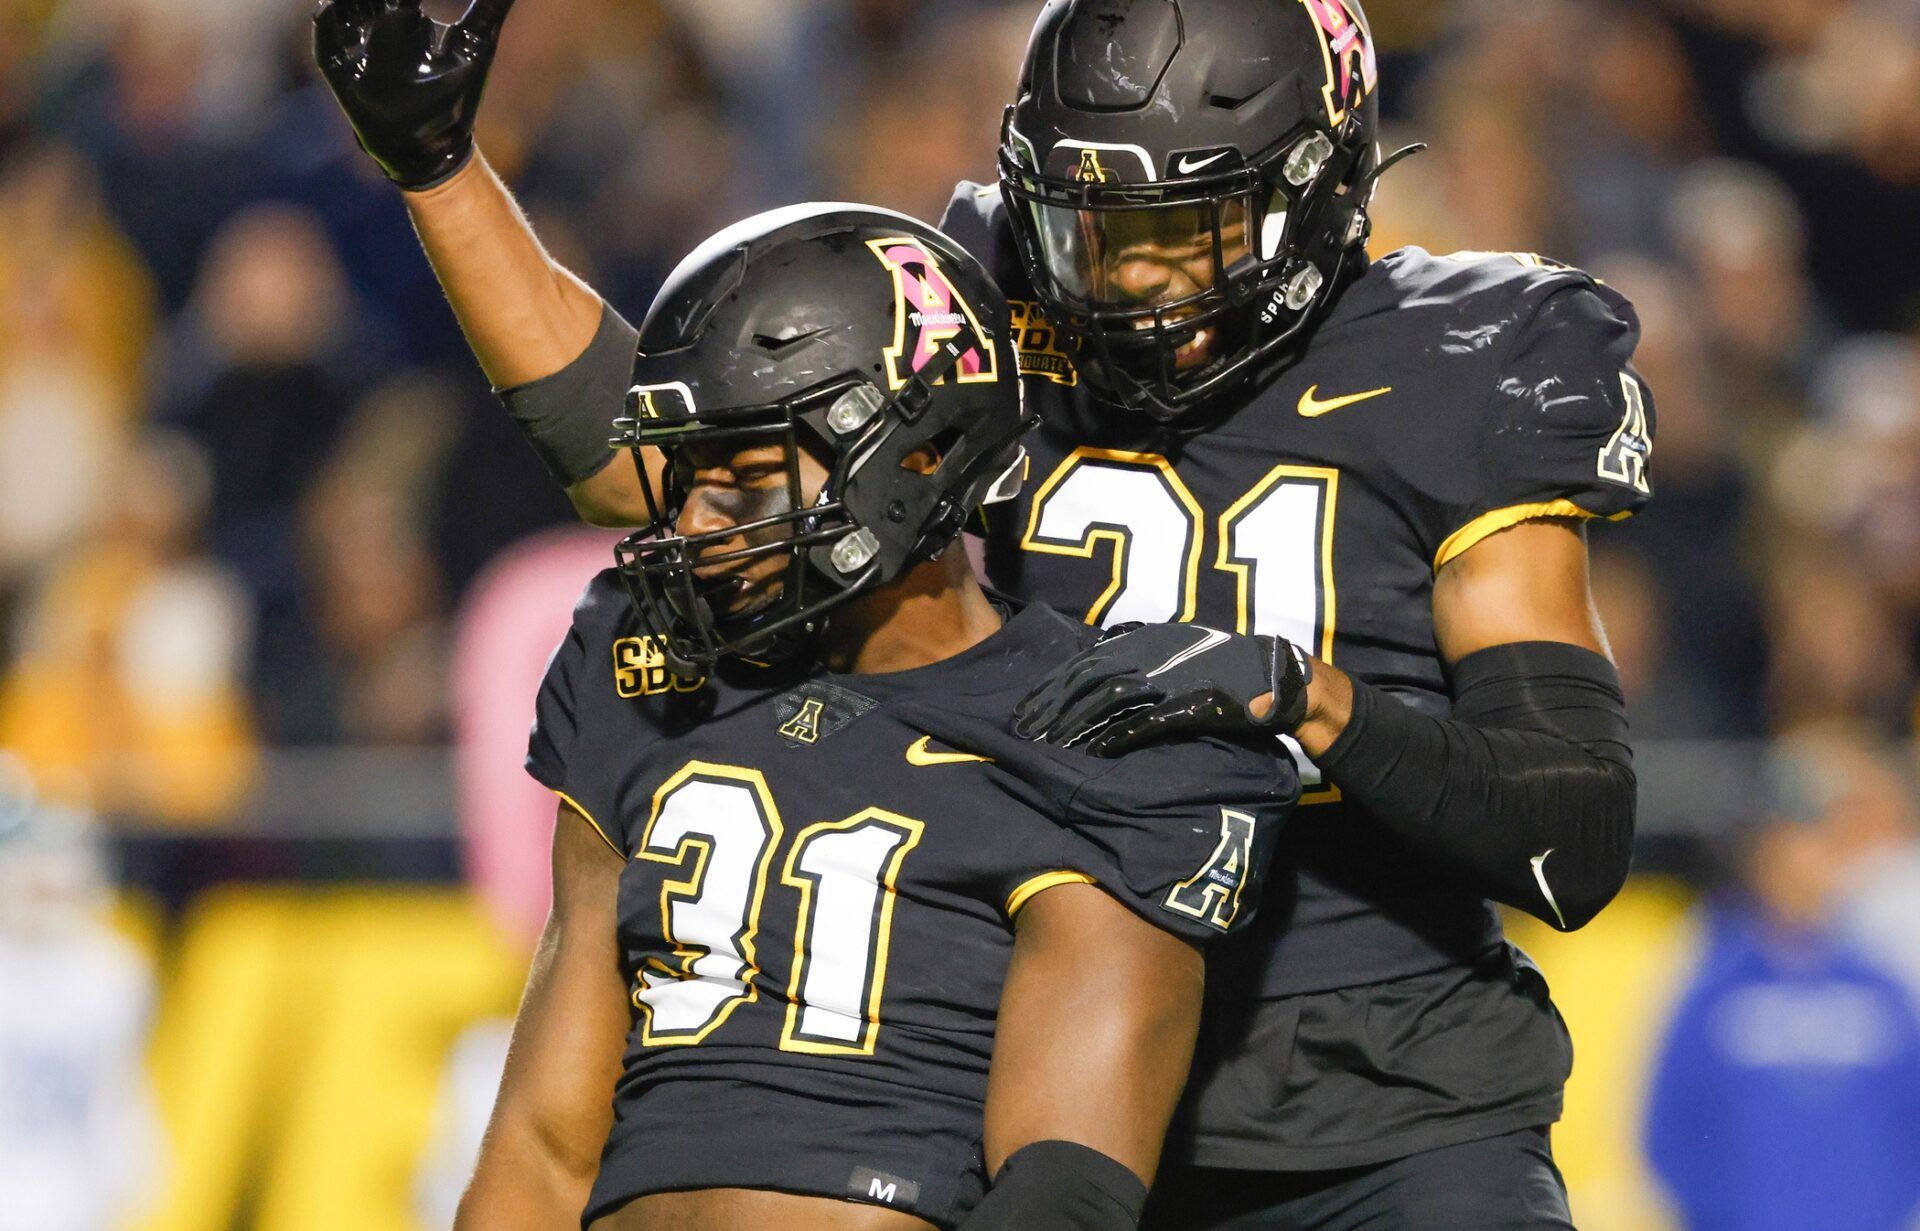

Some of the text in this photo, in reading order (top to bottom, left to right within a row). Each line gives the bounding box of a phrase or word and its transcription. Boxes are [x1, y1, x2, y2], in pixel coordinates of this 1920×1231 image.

[864, 237, 998, 391] A
[1597, 371, 1653, 493] A
[779, 699, 824, 743] A
[633, 760, 925, 1055] 31
[1165, 808, 1256, 929] A
[867, 1177, 897, 1203] M
